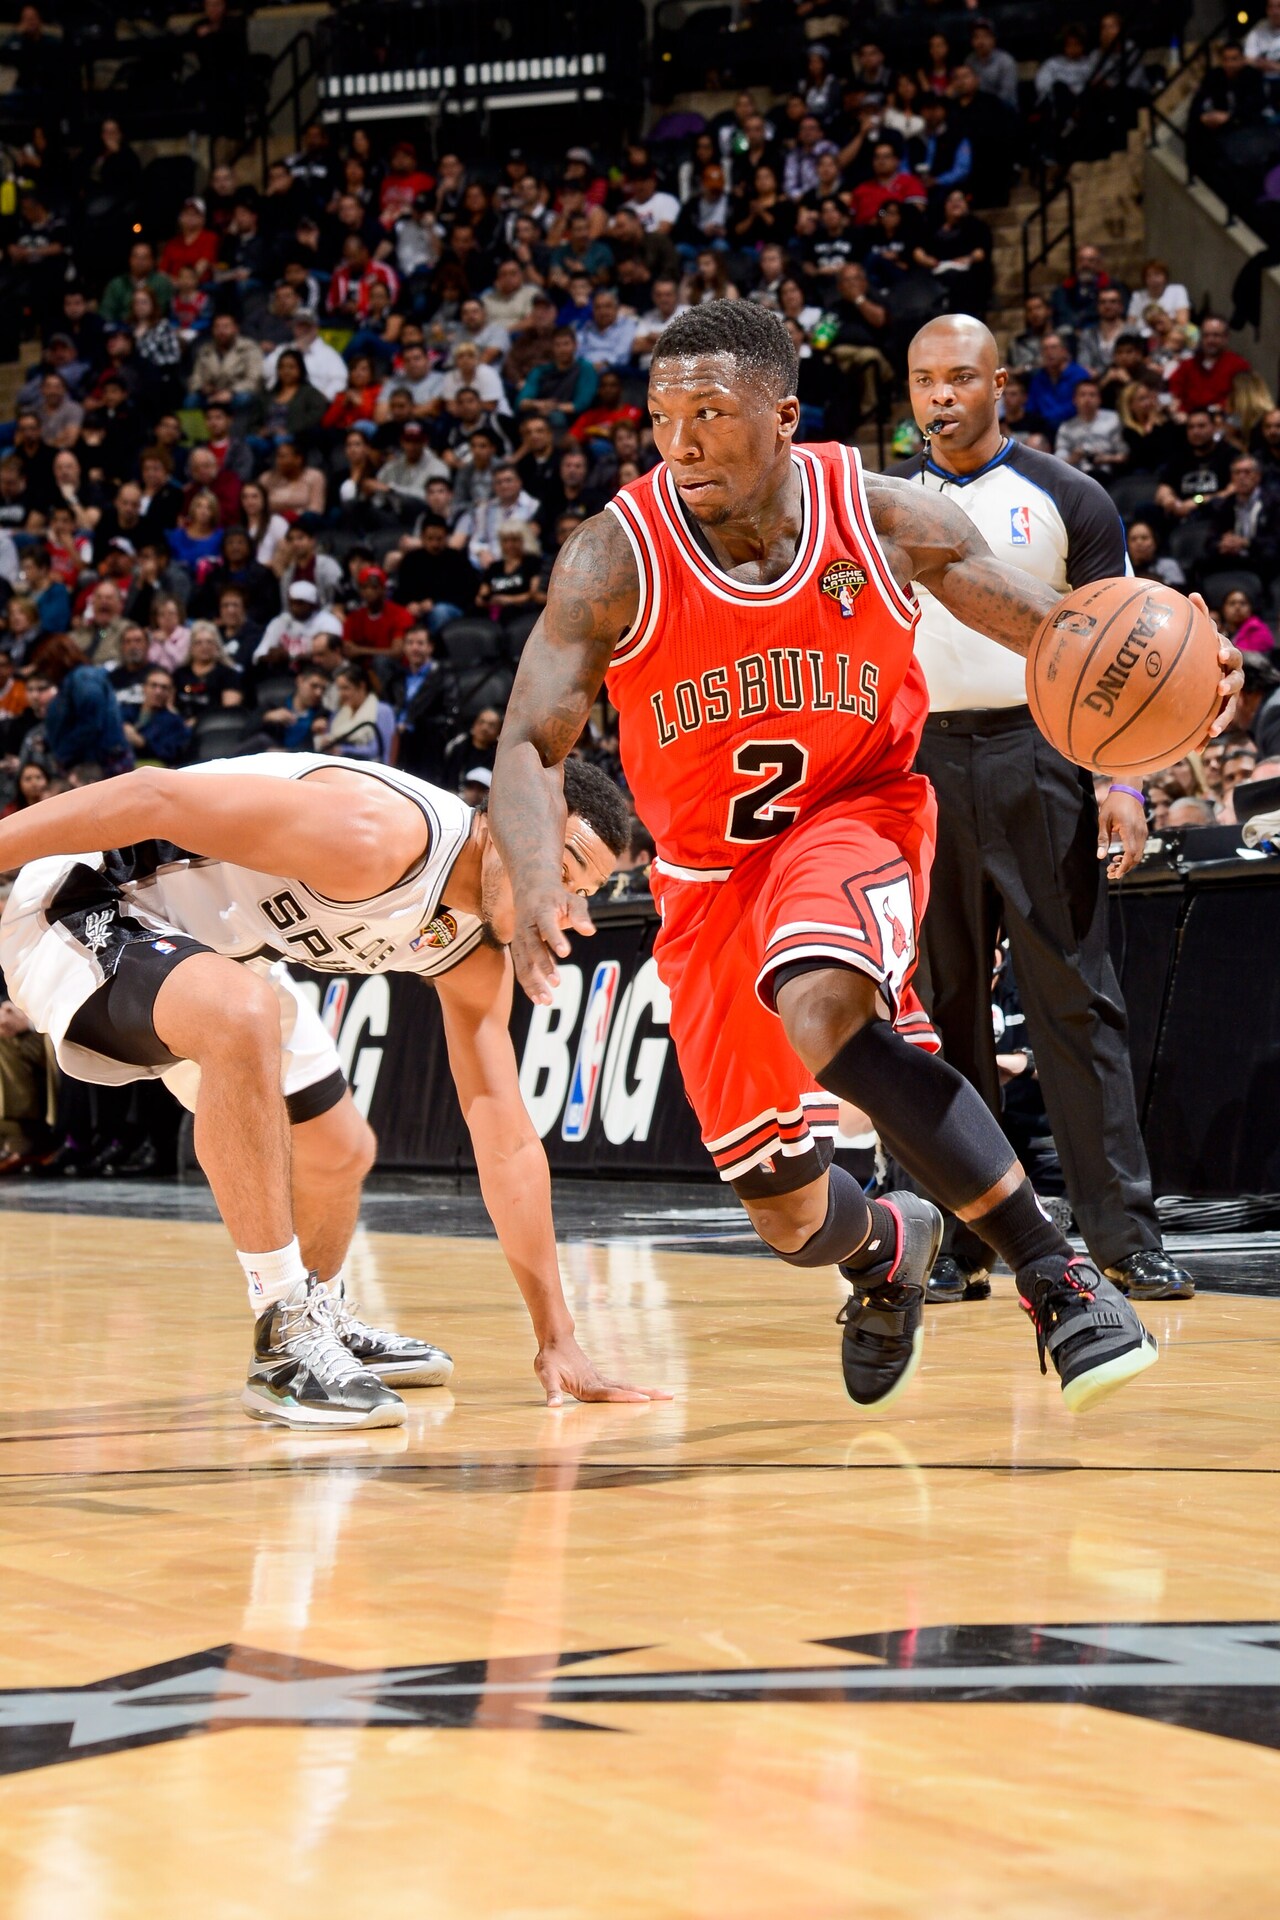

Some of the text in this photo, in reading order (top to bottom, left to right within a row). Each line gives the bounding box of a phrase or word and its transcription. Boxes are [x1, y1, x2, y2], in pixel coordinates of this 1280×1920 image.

[822, 576, 865, 590] LATINA
[823, 570, 863, 584] NOCHE
[651, 648, 880, 749] LOS BULLS
[1083, 595, 1174, 718] SPALDING
[724, 738, 809, 845] 2
